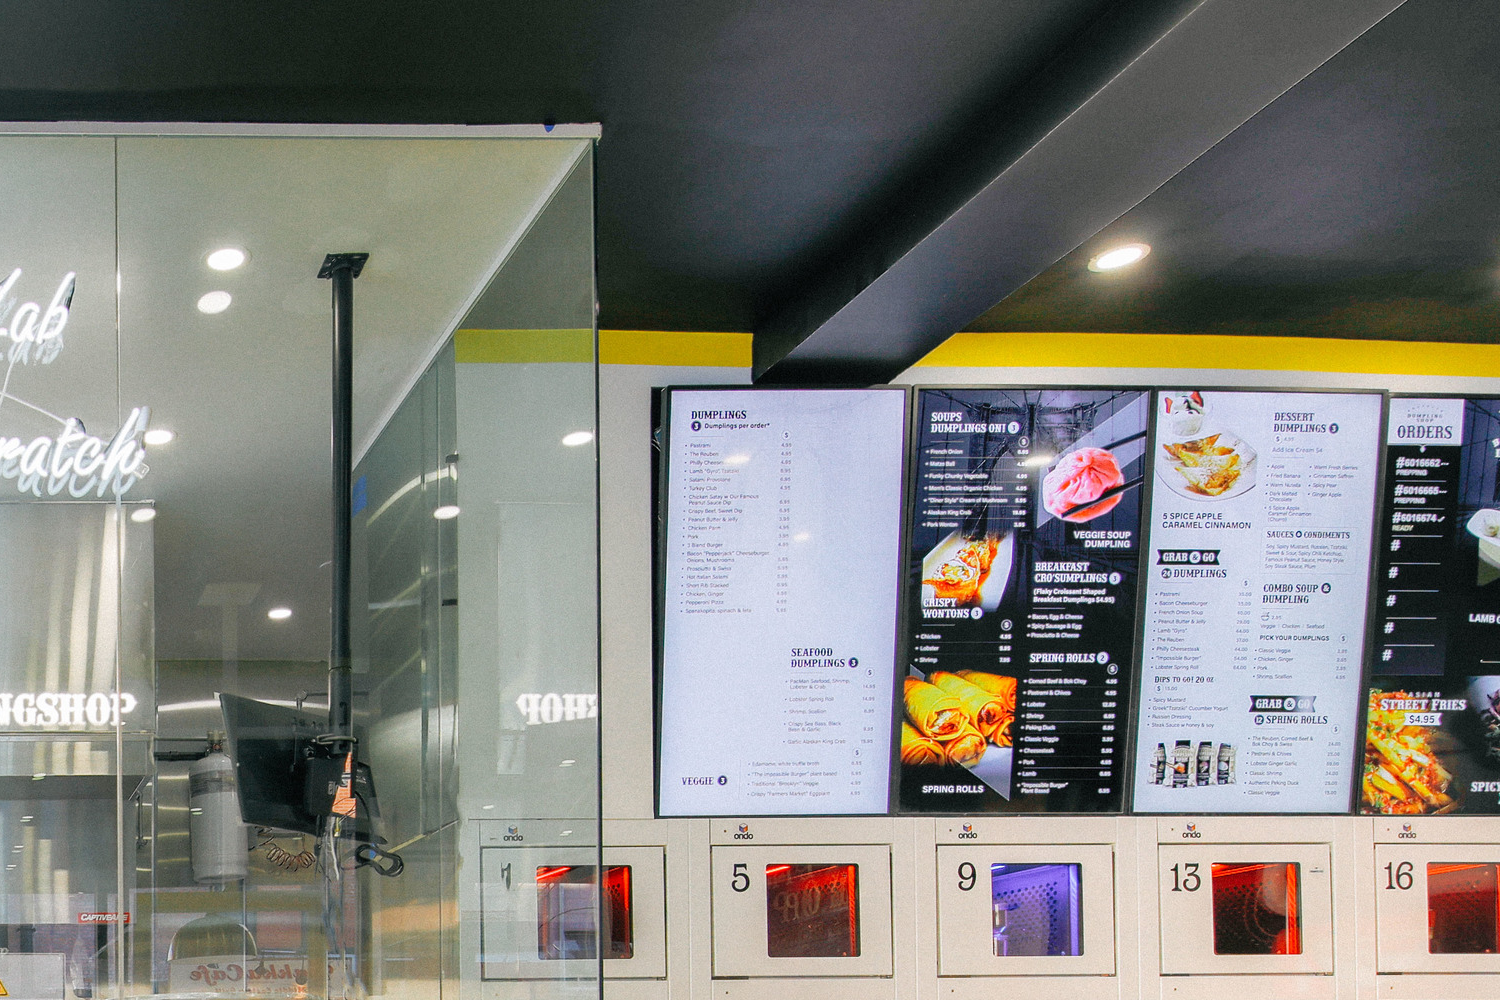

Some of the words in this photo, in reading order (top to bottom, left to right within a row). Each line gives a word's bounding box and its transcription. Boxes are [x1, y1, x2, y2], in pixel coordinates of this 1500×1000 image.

[691, 410, 747, 419] DUMPLINGS
[931, 412, 962, 422] SOUPS
[1274, 413, 1314, 421] DESSERT
[931, 424, 987, 433] DUMPLINGS
[988, 424, 1006, 433] ON!
[1274, 424, 1326, 433] DUMPLINGS
[1397, 425, 1453, 439] ORDERS
[1073, 531, 1106, 539] VEGGIE
[1107, 531, 1131, 539] SOUP
[1304, 531, 1350, 539] CONDIMENTS
[1085, 540, 1131, 548] DUMPLING
[1163, 553, 1188, 562] GRAB
[1202, 553, 1215, 562] GO
[1035, 562, 1090, 571] BREAKFAST
[1174, 570, 1227, 578] DUMPLINGS
[1263, 584, 1293, 592] COMBO
[1295, 584, 1318, 593] SOUP
[923, 598, 957, 607] CRISPY
[1263, 595, 1309, 603] DUMPLING
[923, 609, 970, 618] WONTONS
[1469, 613, 1495, 624] LAMB
[791, 648, 833, 657] SEAFOOD
[1030, 653, 1064, 663] SPRING
[1066, 654, 1096, 663] ROLLS
[791, 659, 845, 668] DUMPLINGS
[1256, 699, 1282, 708] GRAB
[1380, 699, 1428, 711] STREET
[1432, 699, 1467, 711] FRIES
[1266, 716, 1298, 724] SPRING
[1301, 716, 1328, 724] ROLLS
[1409, 715, 1435, 724] $4.95
[682, 777, 713, 785] VEGGIE
[922, 785, 954, 793] SPRING
[956, 785, 985, 793] ROLLS
[734, 832, 753, 840] ondo
[958, 830, 977, 839] ondo
[1182, 830, 1201, 839] ondo
[1398, 830, 1417, 839] ondo
[732, 863, 750, 892] 5
[958, 862, 977, 891] 9
[1170, 862, 1201, 892] 13
[1384, 861, 1414, 890] 16
